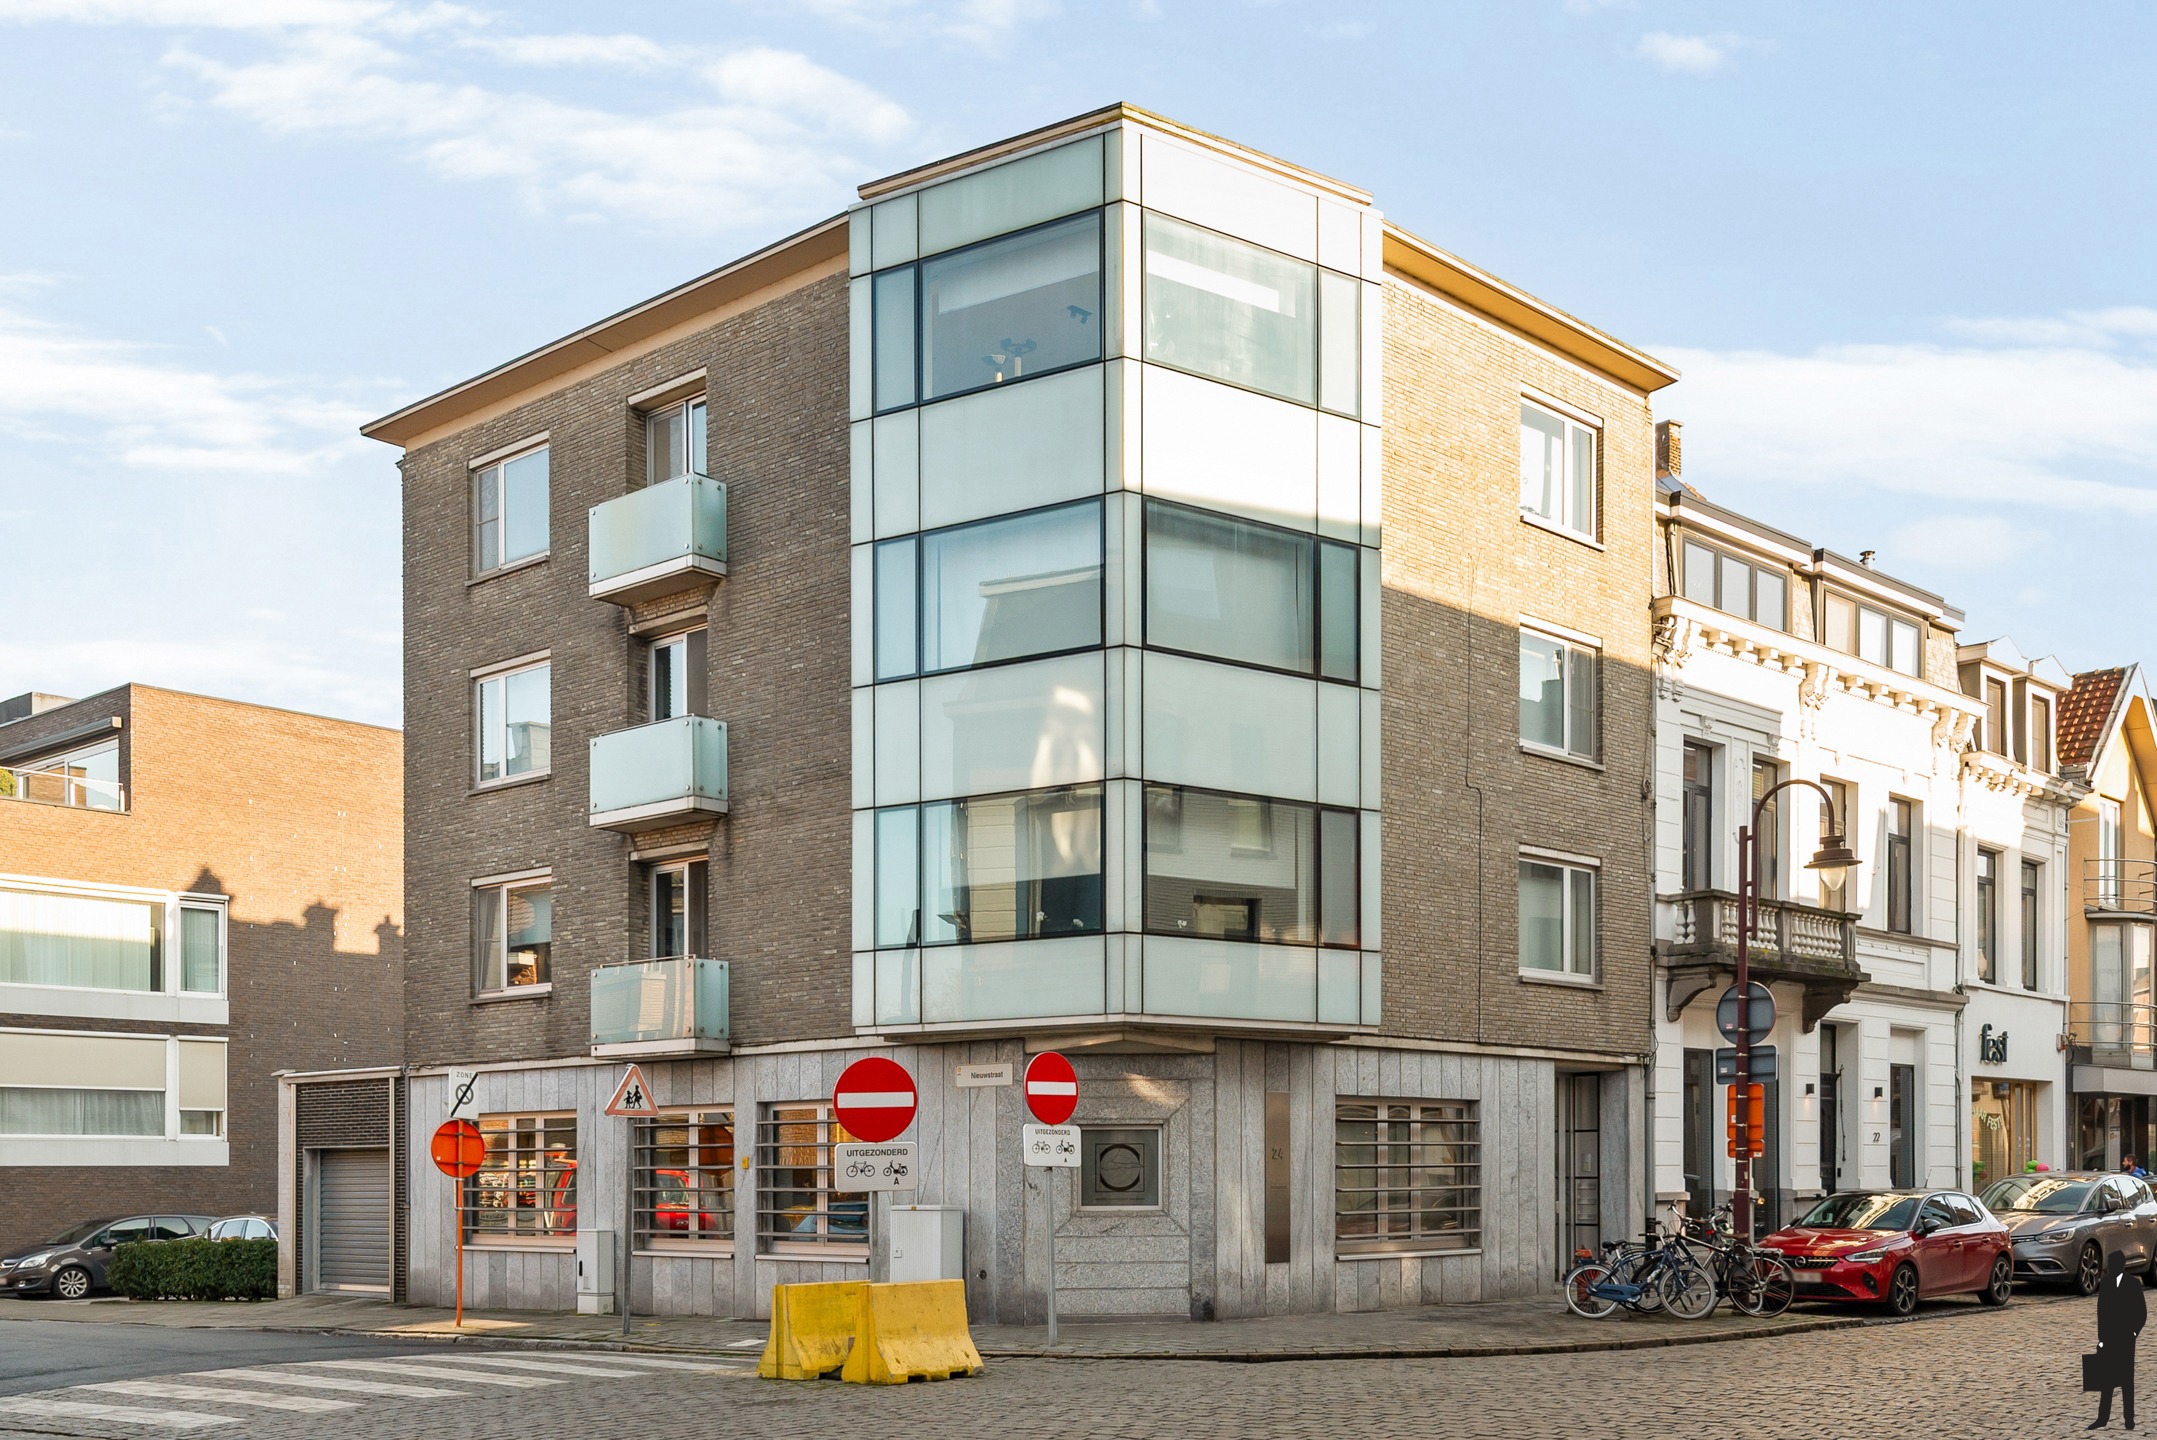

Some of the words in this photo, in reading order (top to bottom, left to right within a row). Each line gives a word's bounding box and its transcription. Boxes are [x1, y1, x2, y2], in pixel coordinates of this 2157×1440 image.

[456, 1071, 474, 1079] ZONE
[970, 1071, 1004, 1079] Nieuwstraat
[1034, 1128, 1071, 1136] UITGEZONDERD
[1872, 1132, 1881, 1143] 22
[846, 1148, 909, 1157] UITGEZONDERD
[893, 1176, 900, 1186] A
